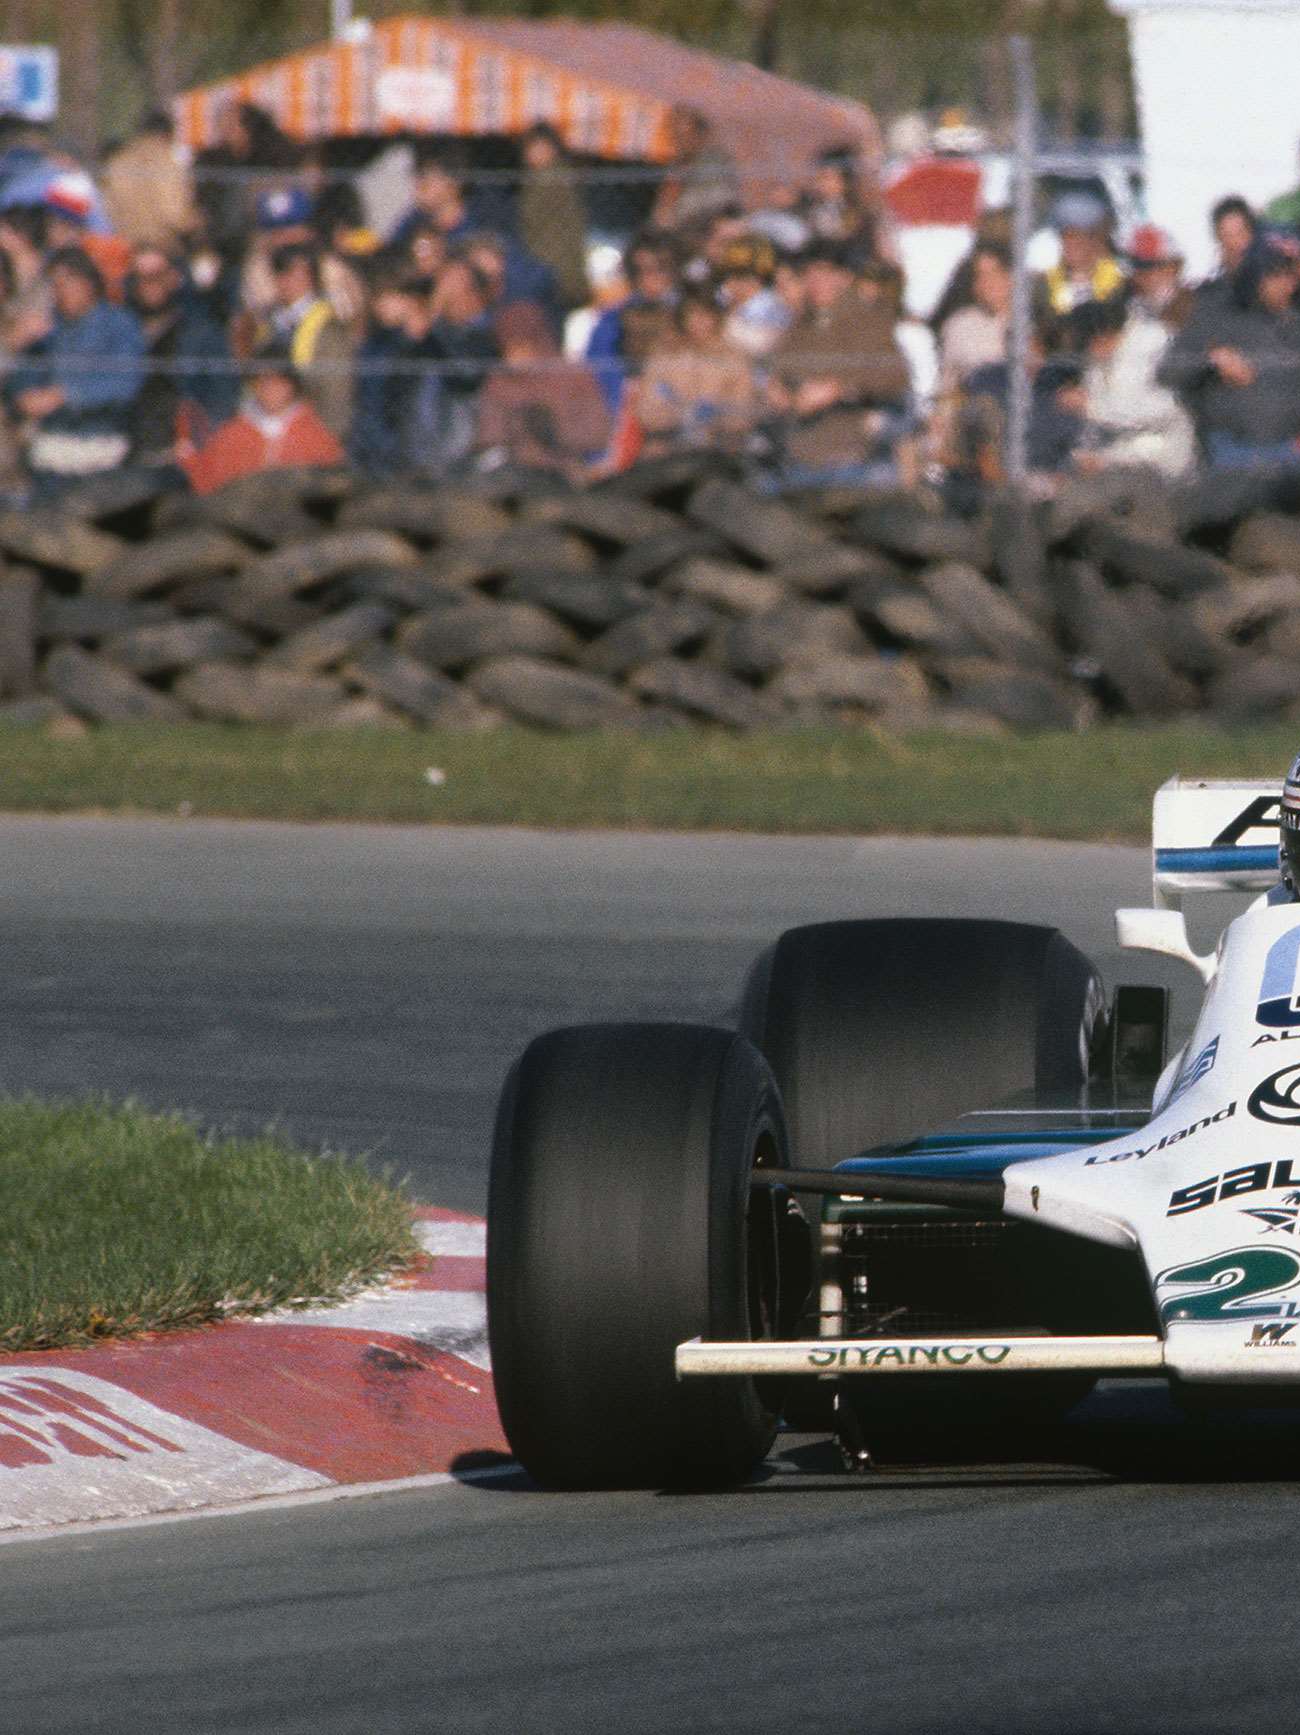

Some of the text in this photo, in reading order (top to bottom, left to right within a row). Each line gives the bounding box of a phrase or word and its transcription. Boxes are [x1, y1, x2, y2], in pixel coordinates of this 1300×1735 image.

[1084, 1101, 1238, 1167] Leyland
[807, 1344, 1012, 1367] SIYANCO
[1243, 1340, 1297, 1348] WILLIAMS
